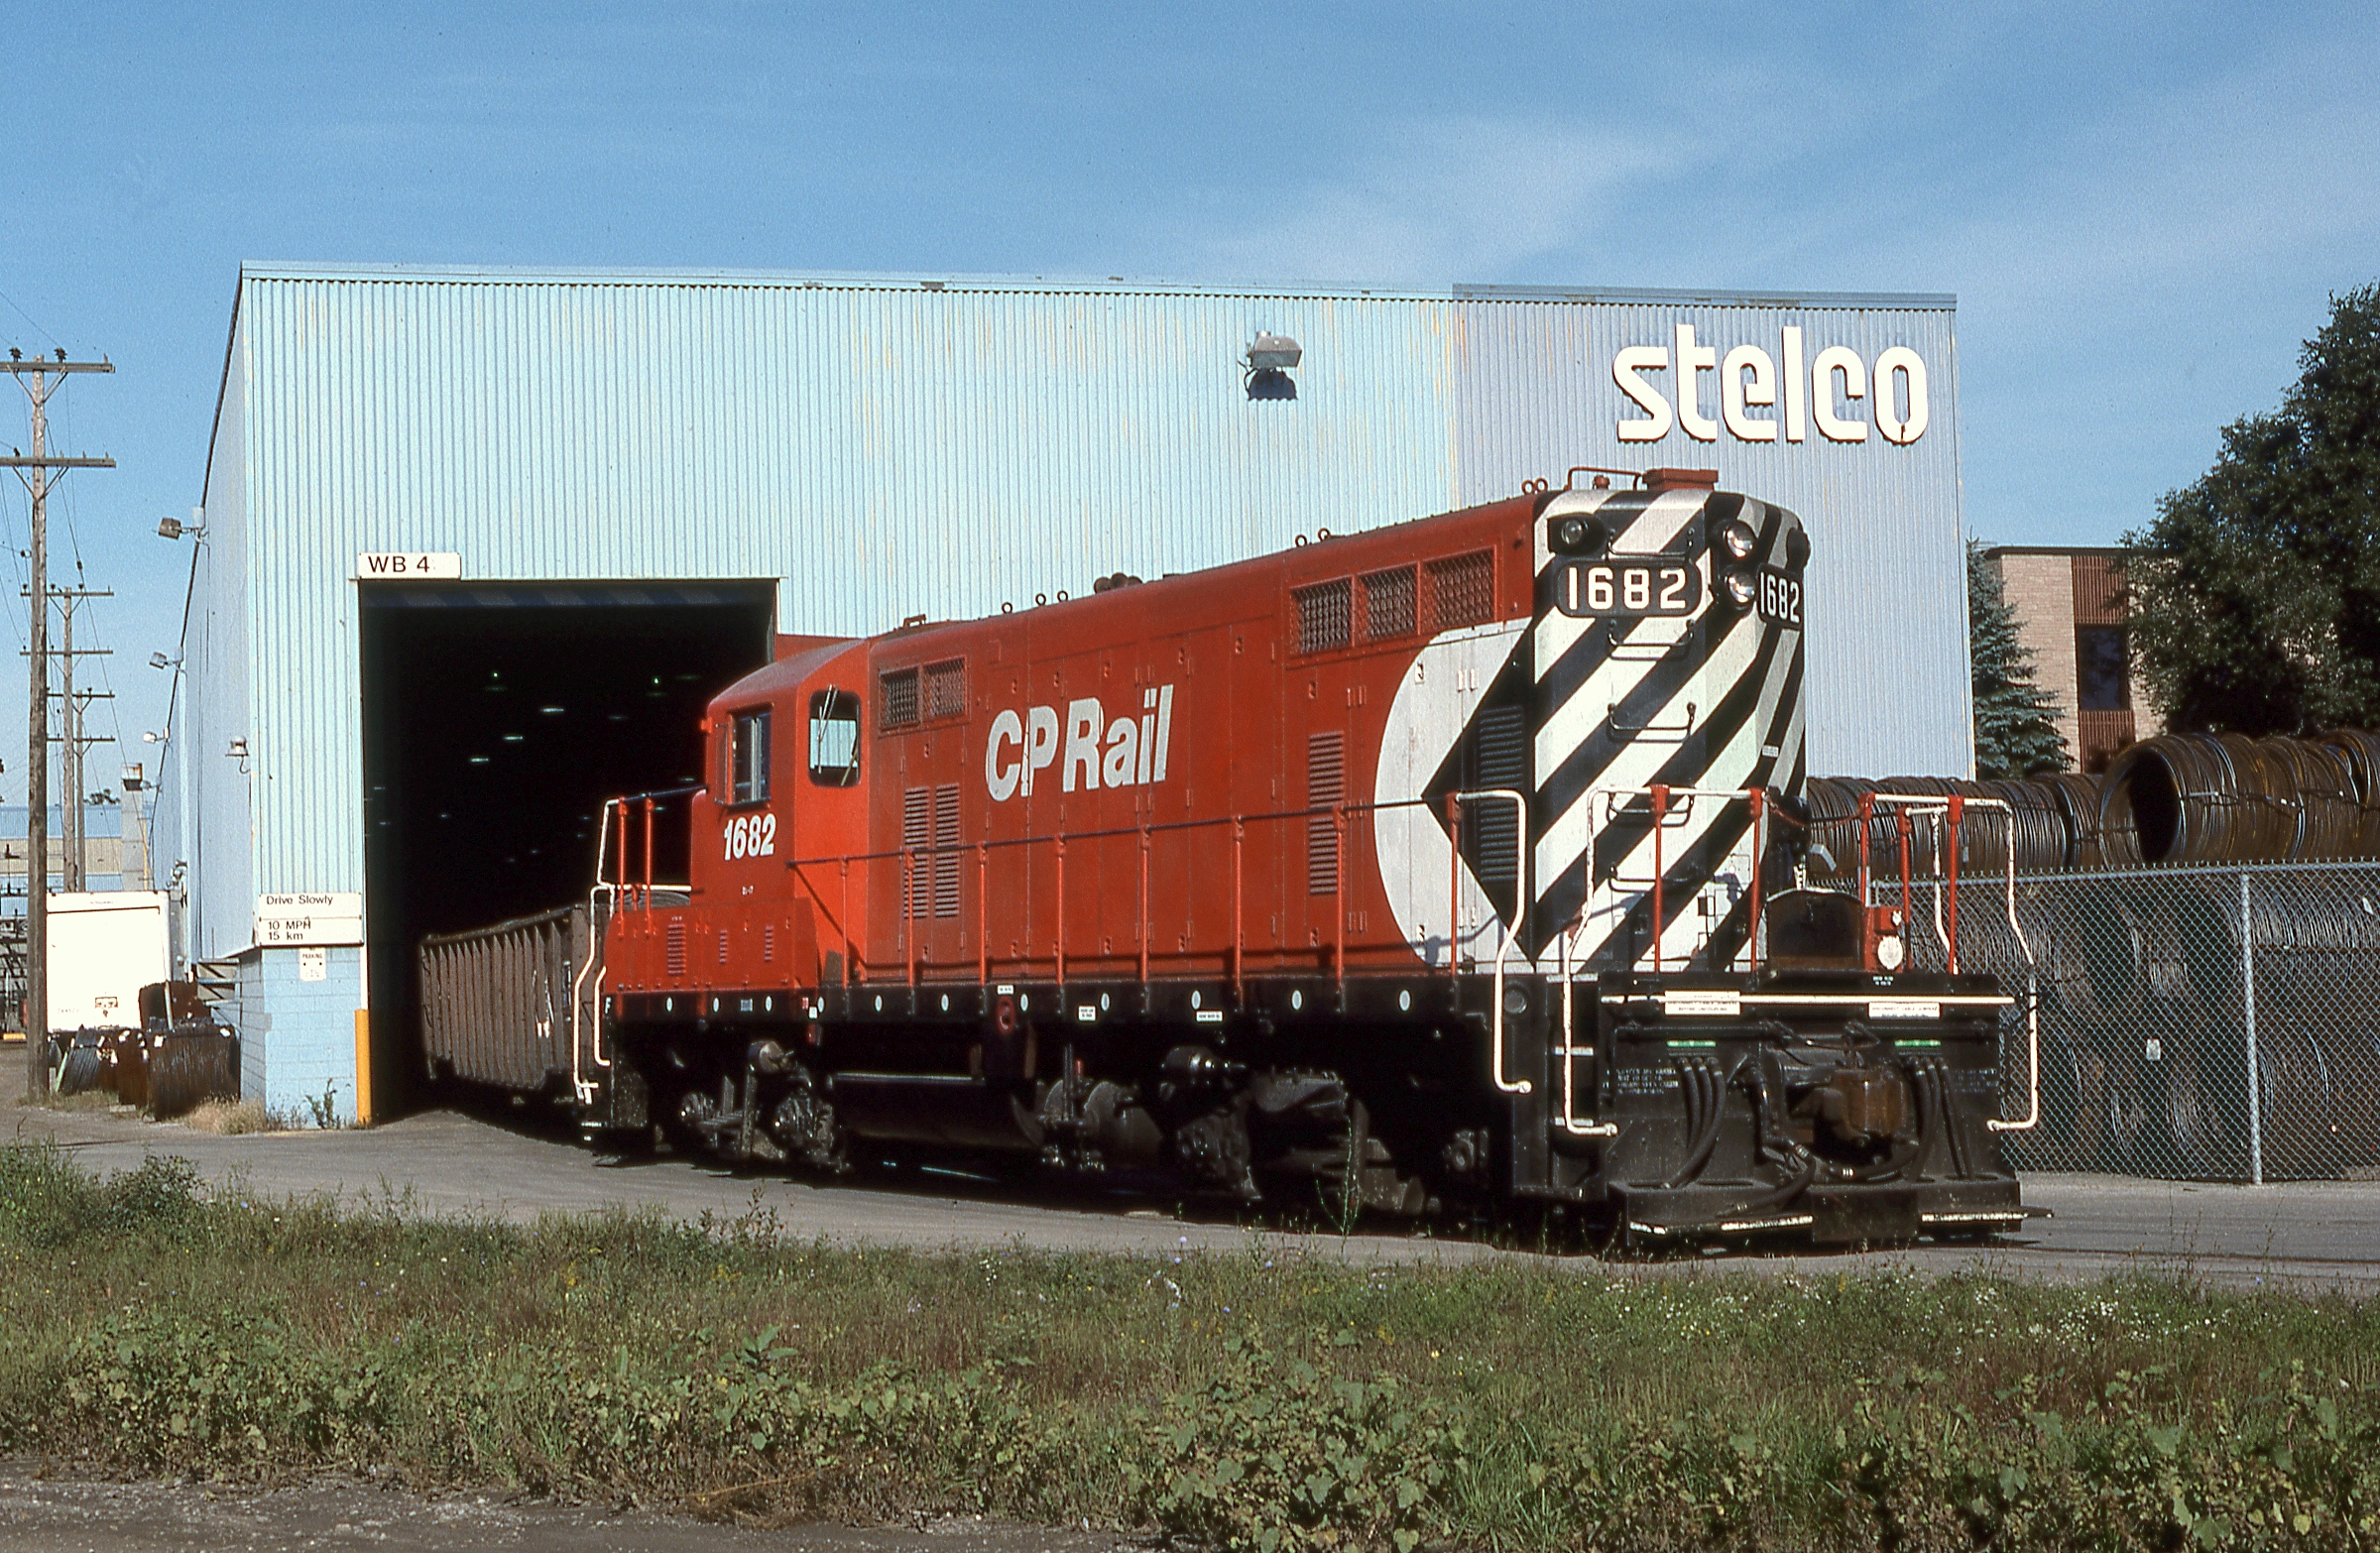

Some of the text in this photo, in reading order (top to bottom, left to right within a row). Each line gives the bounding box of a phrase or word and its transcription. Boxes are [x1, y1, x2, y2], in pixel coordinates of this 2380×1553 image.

[1612, 324, 1929, 444] stelco
[368, 555, 430, 573] WB 4
[1567, 566, 1687, 610] 1682
[1760, 572, 1801, 623] 1682
[985, 684, 1174, 802] CP Rail
[723, 812, 776, 861] 1682
[266, 895, 333, 905] Drive Slowly
[268, 920, 311, 930] 10 MPH
[268, 931, 303, 940] 15 km
